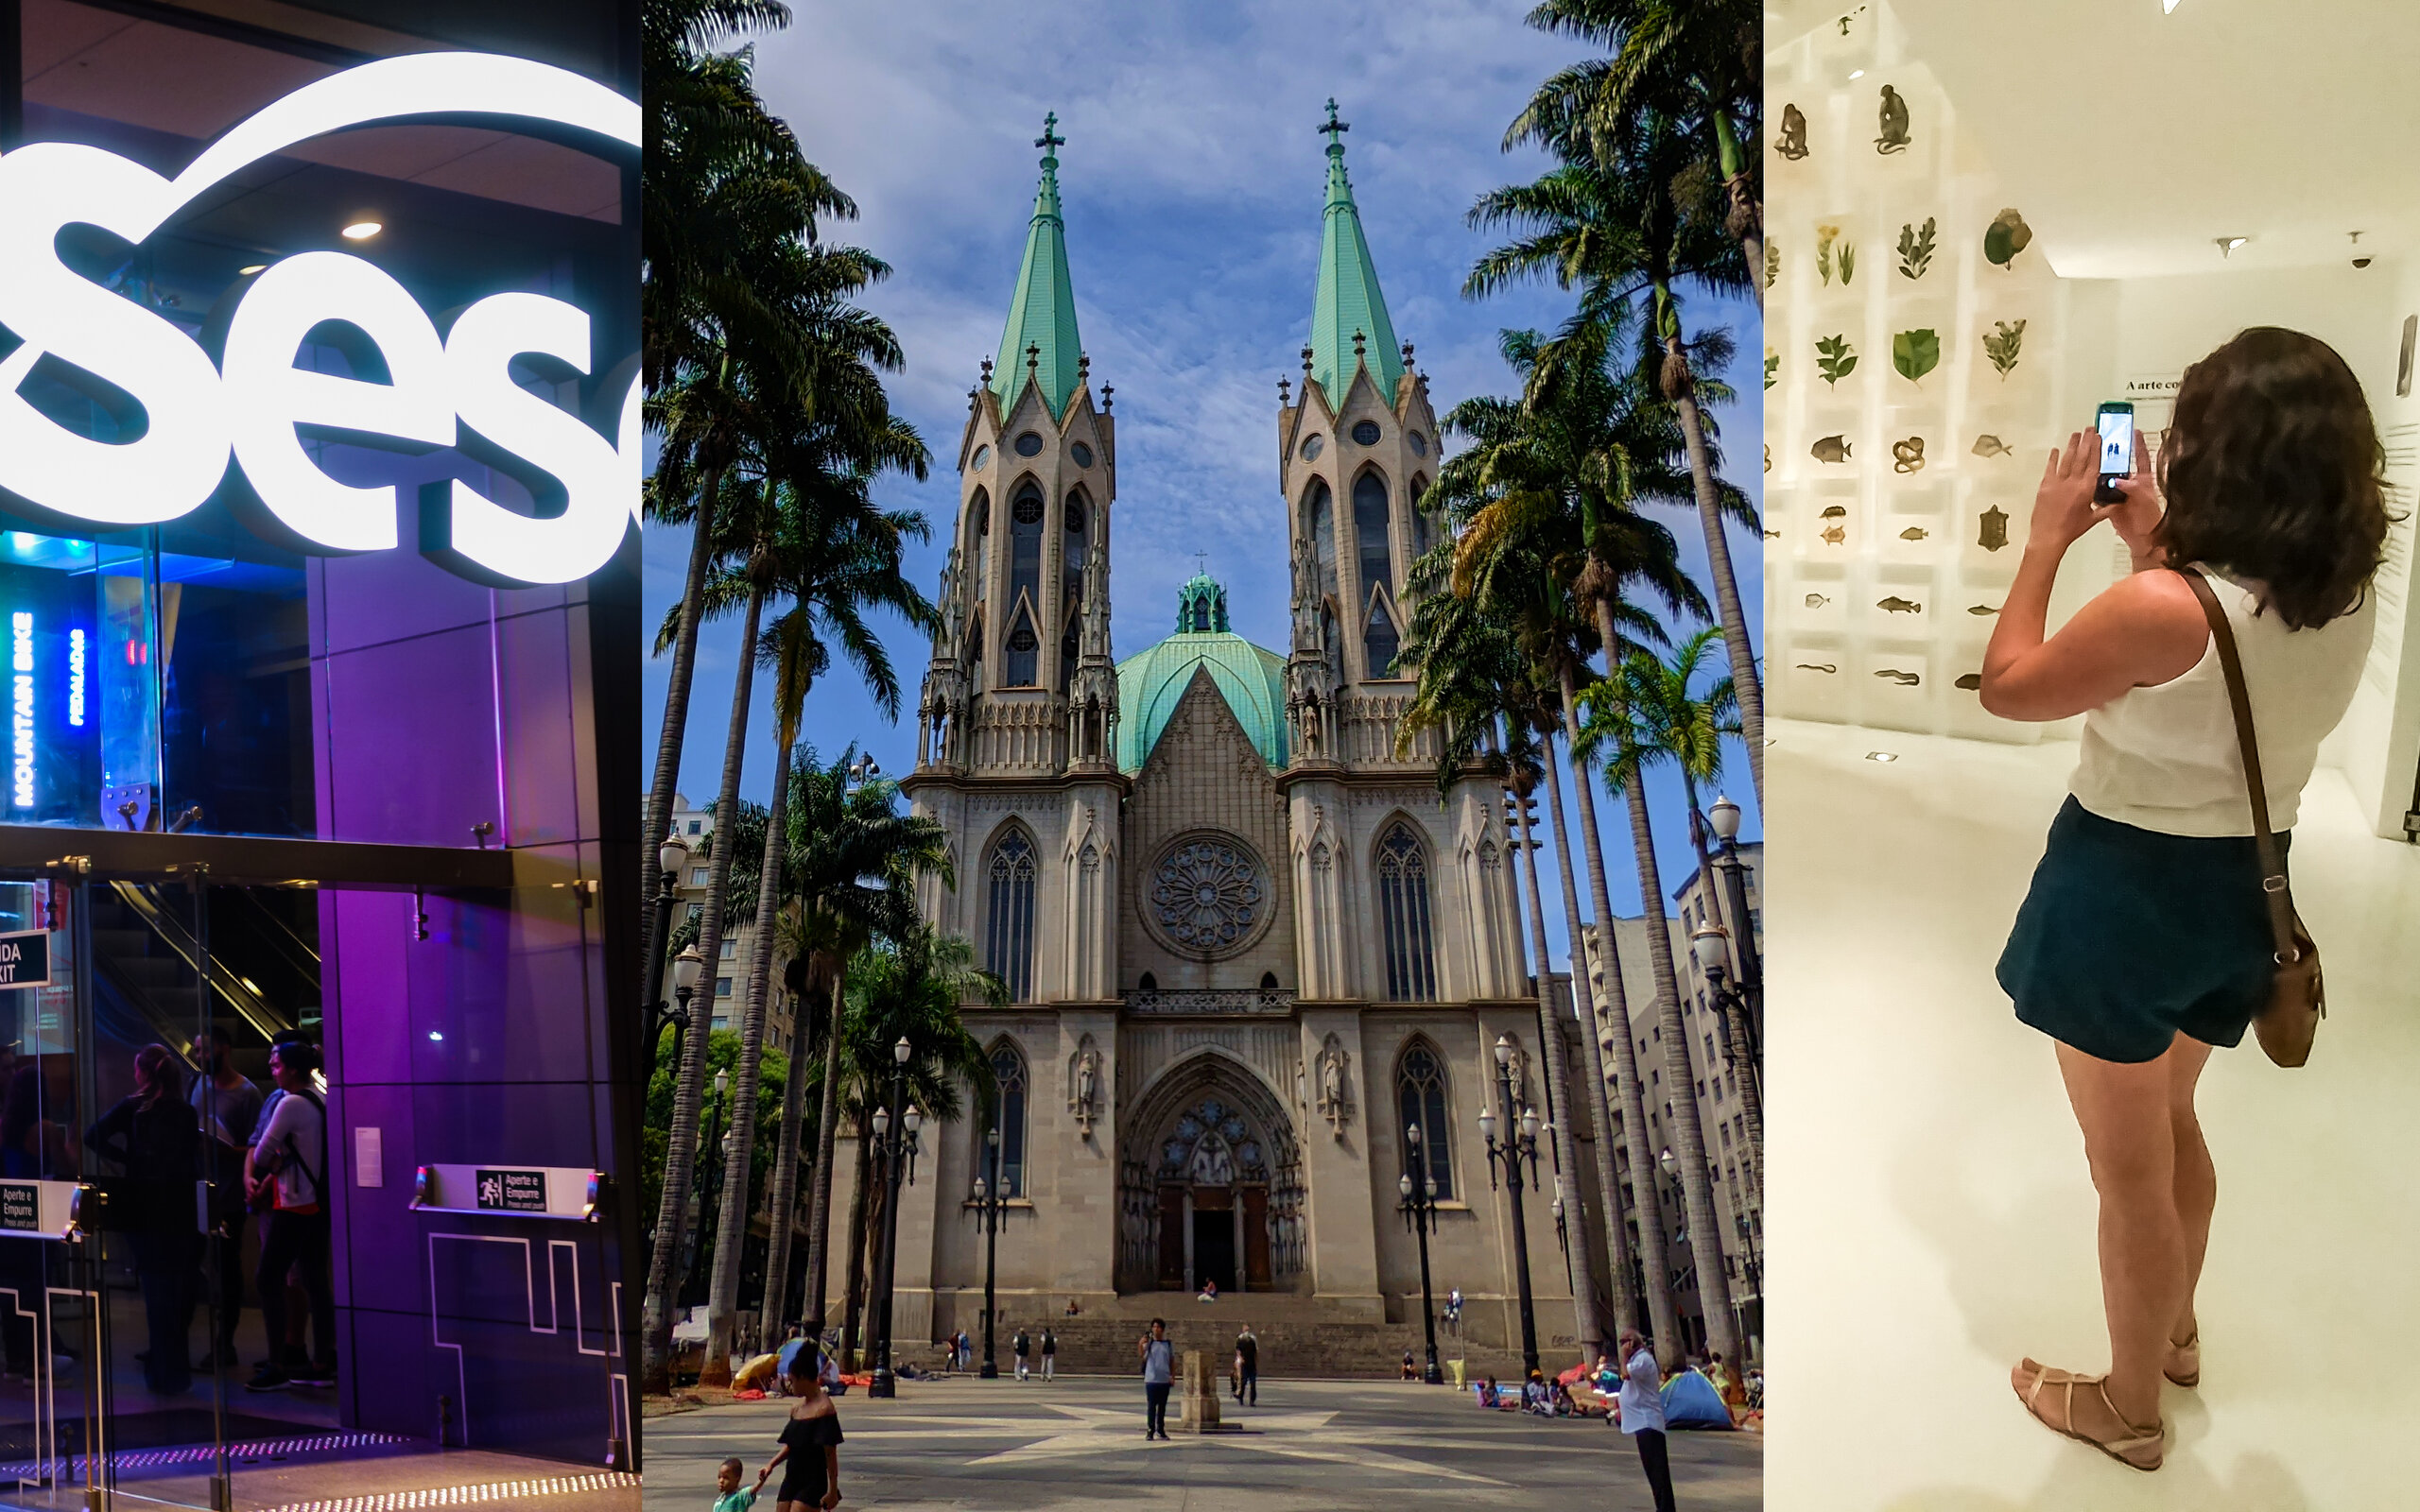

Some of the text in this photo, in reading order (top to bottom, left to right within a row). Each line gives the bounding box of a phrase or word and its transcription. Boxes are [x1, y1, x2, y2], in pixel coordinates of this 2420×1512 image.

[2126, 381, 2135, 390] A
[2137, 381, 2162, 390] arte
[70, 628, 85, 726] PEDALADAS
[13, 612, 33, 806] MOUNTAIN BIKE
[506, 1174, 539, 1187] Aperte e
[3, 1188, 31, 1202] Aperte e
[506, 1187, 540, 1200] Empurre
[4, 1203, 32, 1217] Empurre
